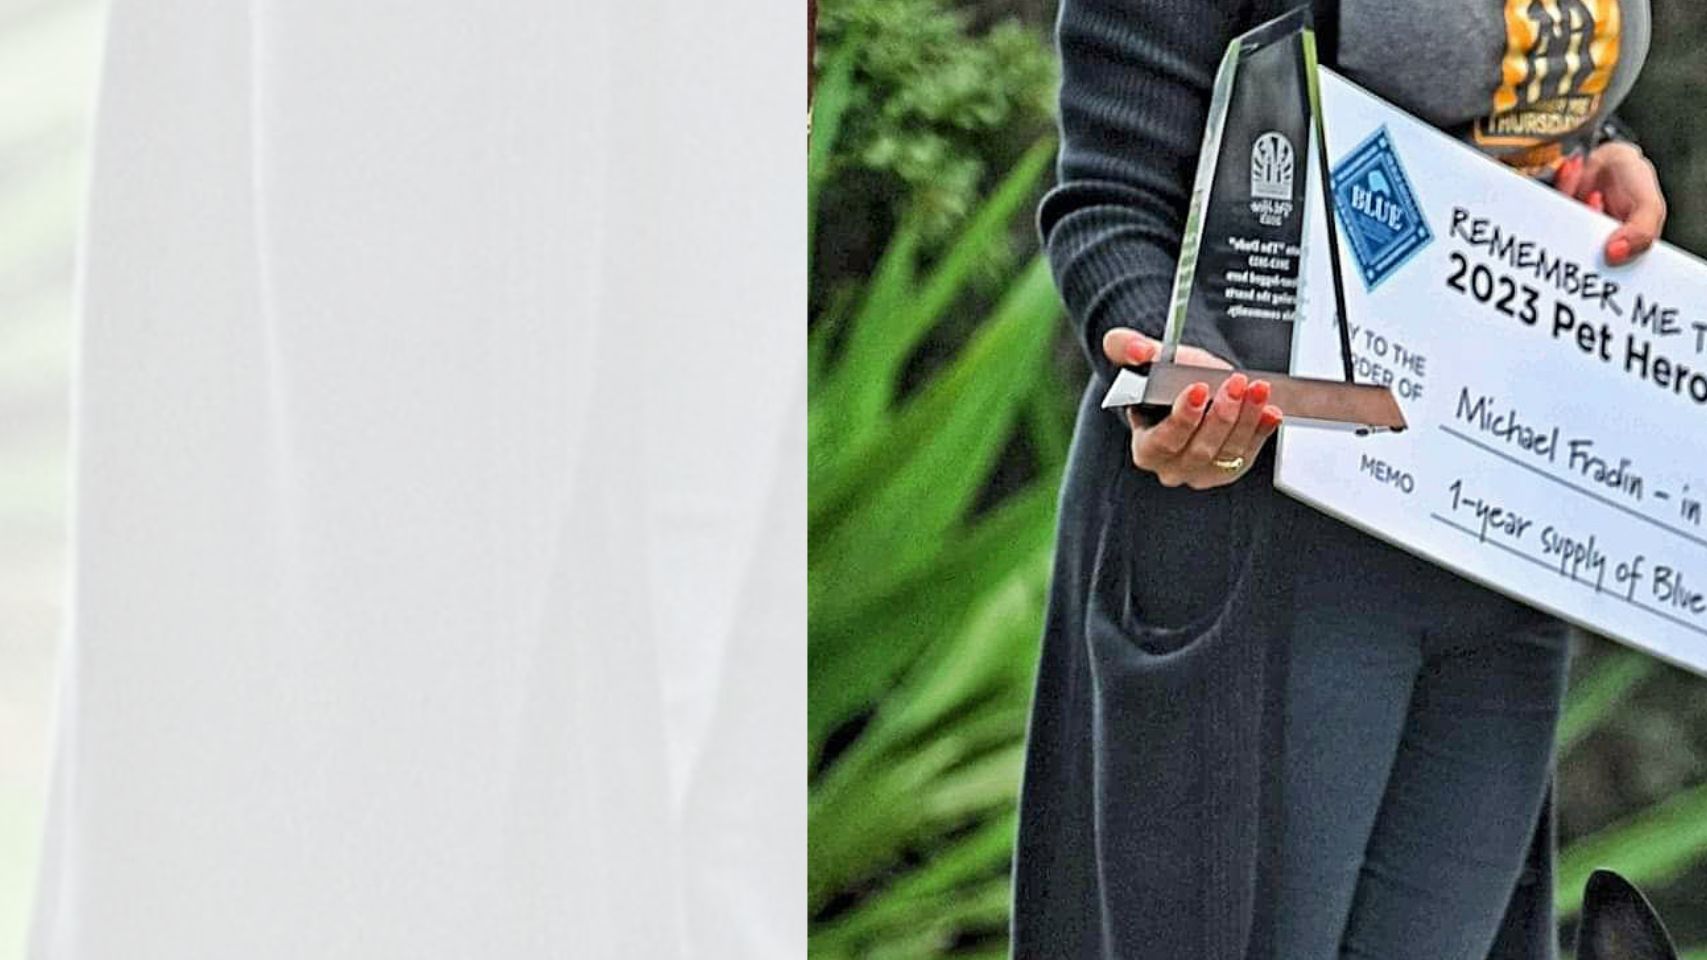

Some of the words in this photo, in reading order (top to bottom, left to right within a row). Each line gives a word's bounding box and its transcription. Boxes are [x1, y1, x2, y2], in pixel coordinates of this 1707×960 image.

[1351, 184, 1403, 232] BLUE
[1446, 251, 1541, 326] 2023
[1552, 301, 1613, 362] Pet
[1449, 206, 1624, 317] REMEMBER
[1631, 292, 1682, 335] ME
[1364, 329, 1389, 357] TO
[1392, 343, 1427, 377] THE
[1398, 377, 1424, 402] OF
[1359, 453, 1416, 495] MEMO
[1455, 385, 1560, 463] Michael
[1567, 438, 1644, 501] Fradin
[1680, 483, 1702, 525] in
[1449, 478, 1533, 543] 1-year
[1540, 525, 1607, 592] supply
[1615, 554, 1646, 602] of
[1652, 564, 1706, 614] Blue
